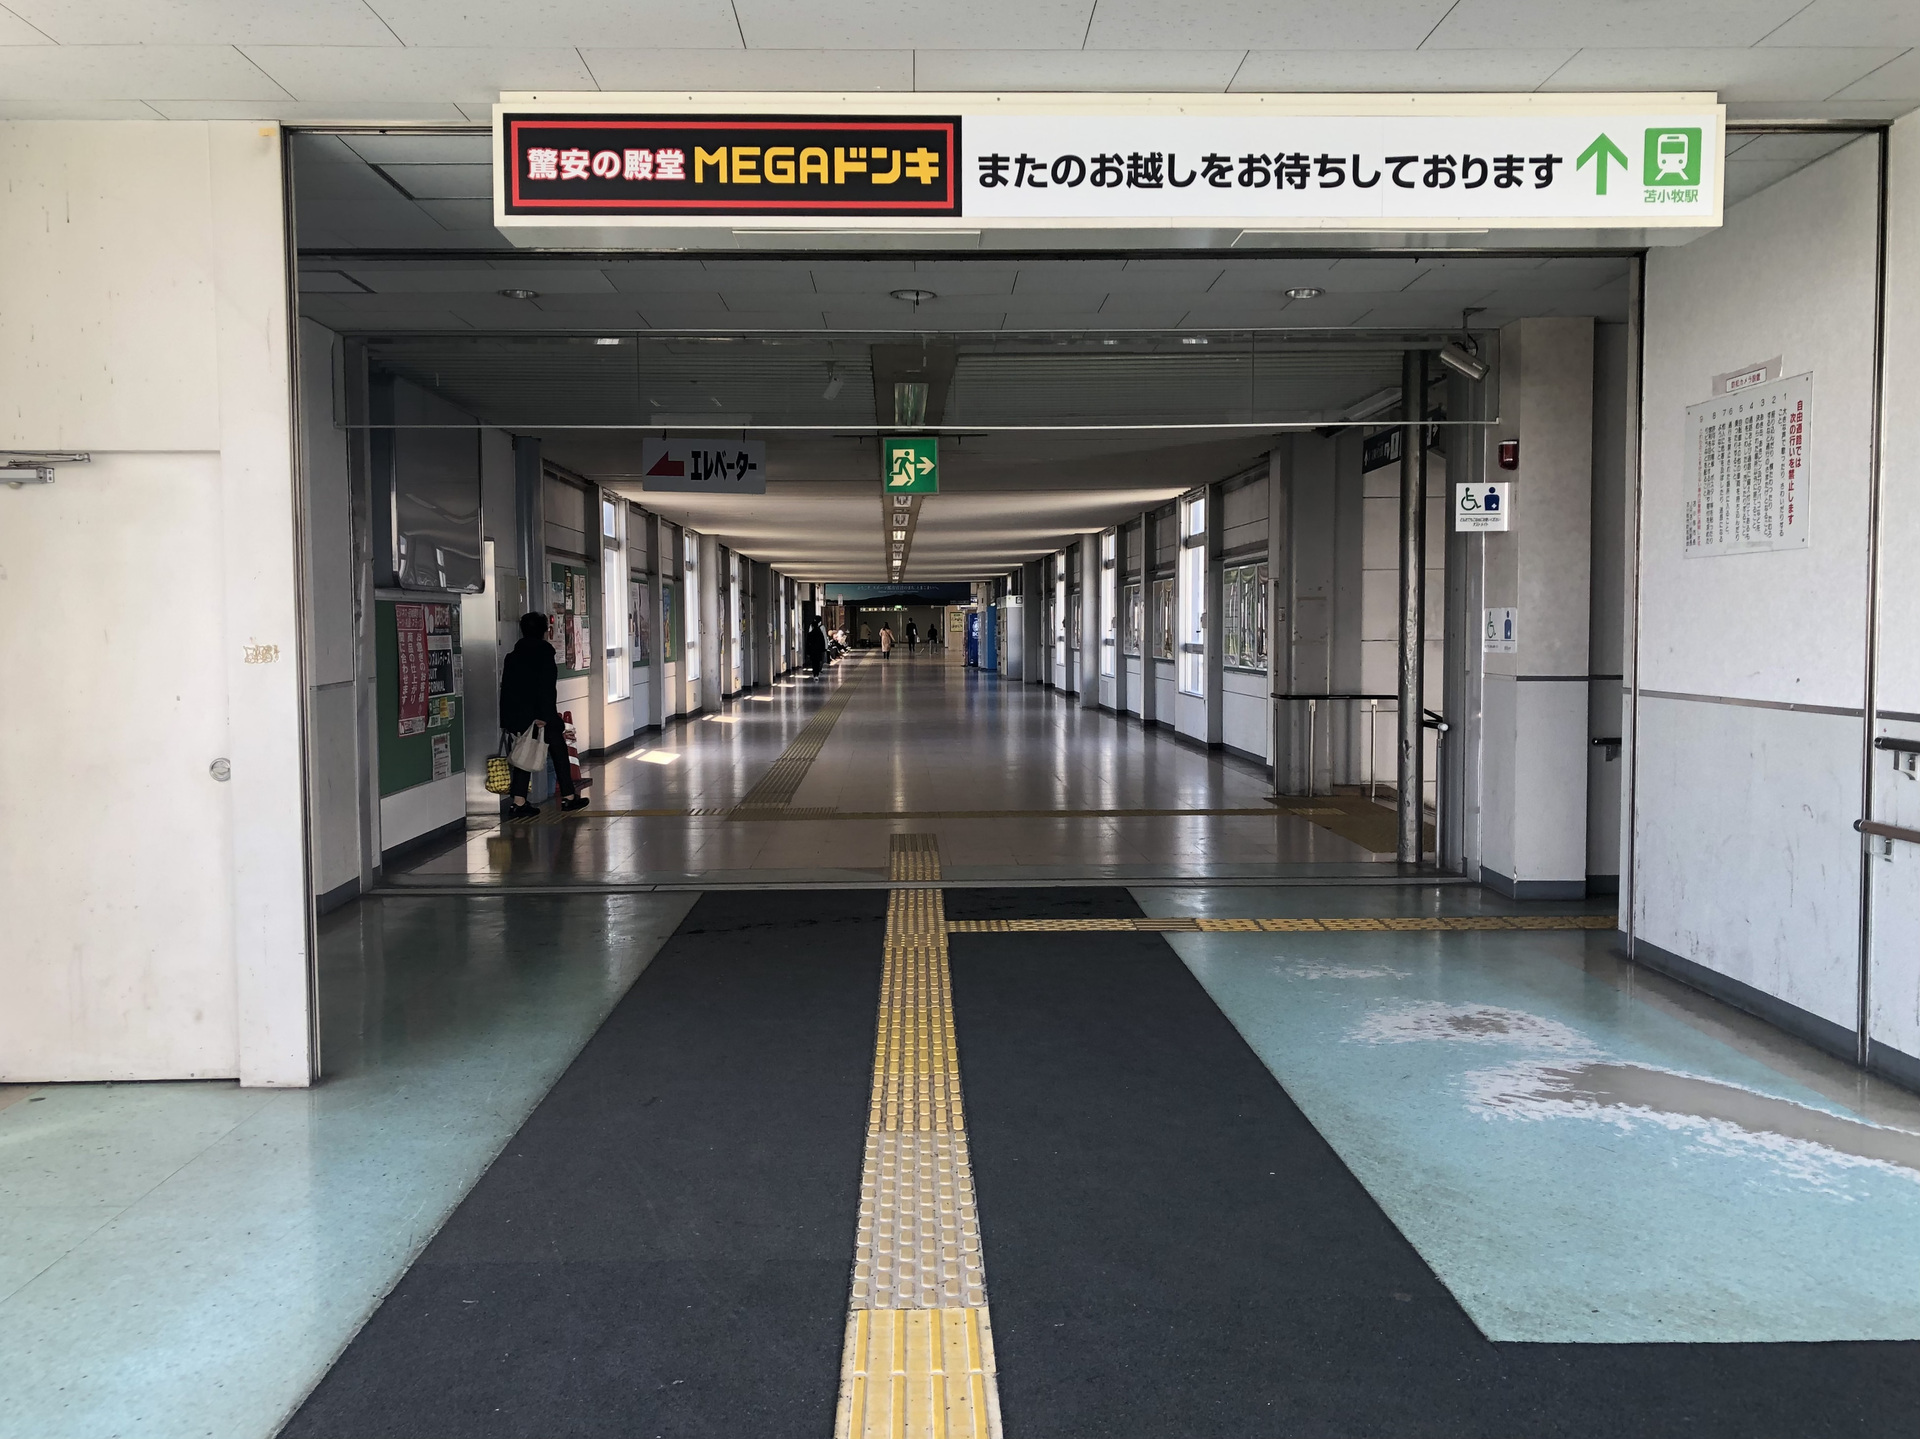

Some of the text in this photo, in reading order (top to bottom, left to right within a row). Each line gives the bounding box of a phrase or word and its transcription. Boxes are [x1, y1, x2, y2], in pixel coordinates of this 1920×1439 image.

[526, 146, 940, 185] 驚安の殿堂 MEGAドンキ
[977, 151, 1563, 190] またのお越しをお待ちしております
[1643, 188, 1699, 204] 苫小牧駅
[690, 450, 757, 481] エレベーター
